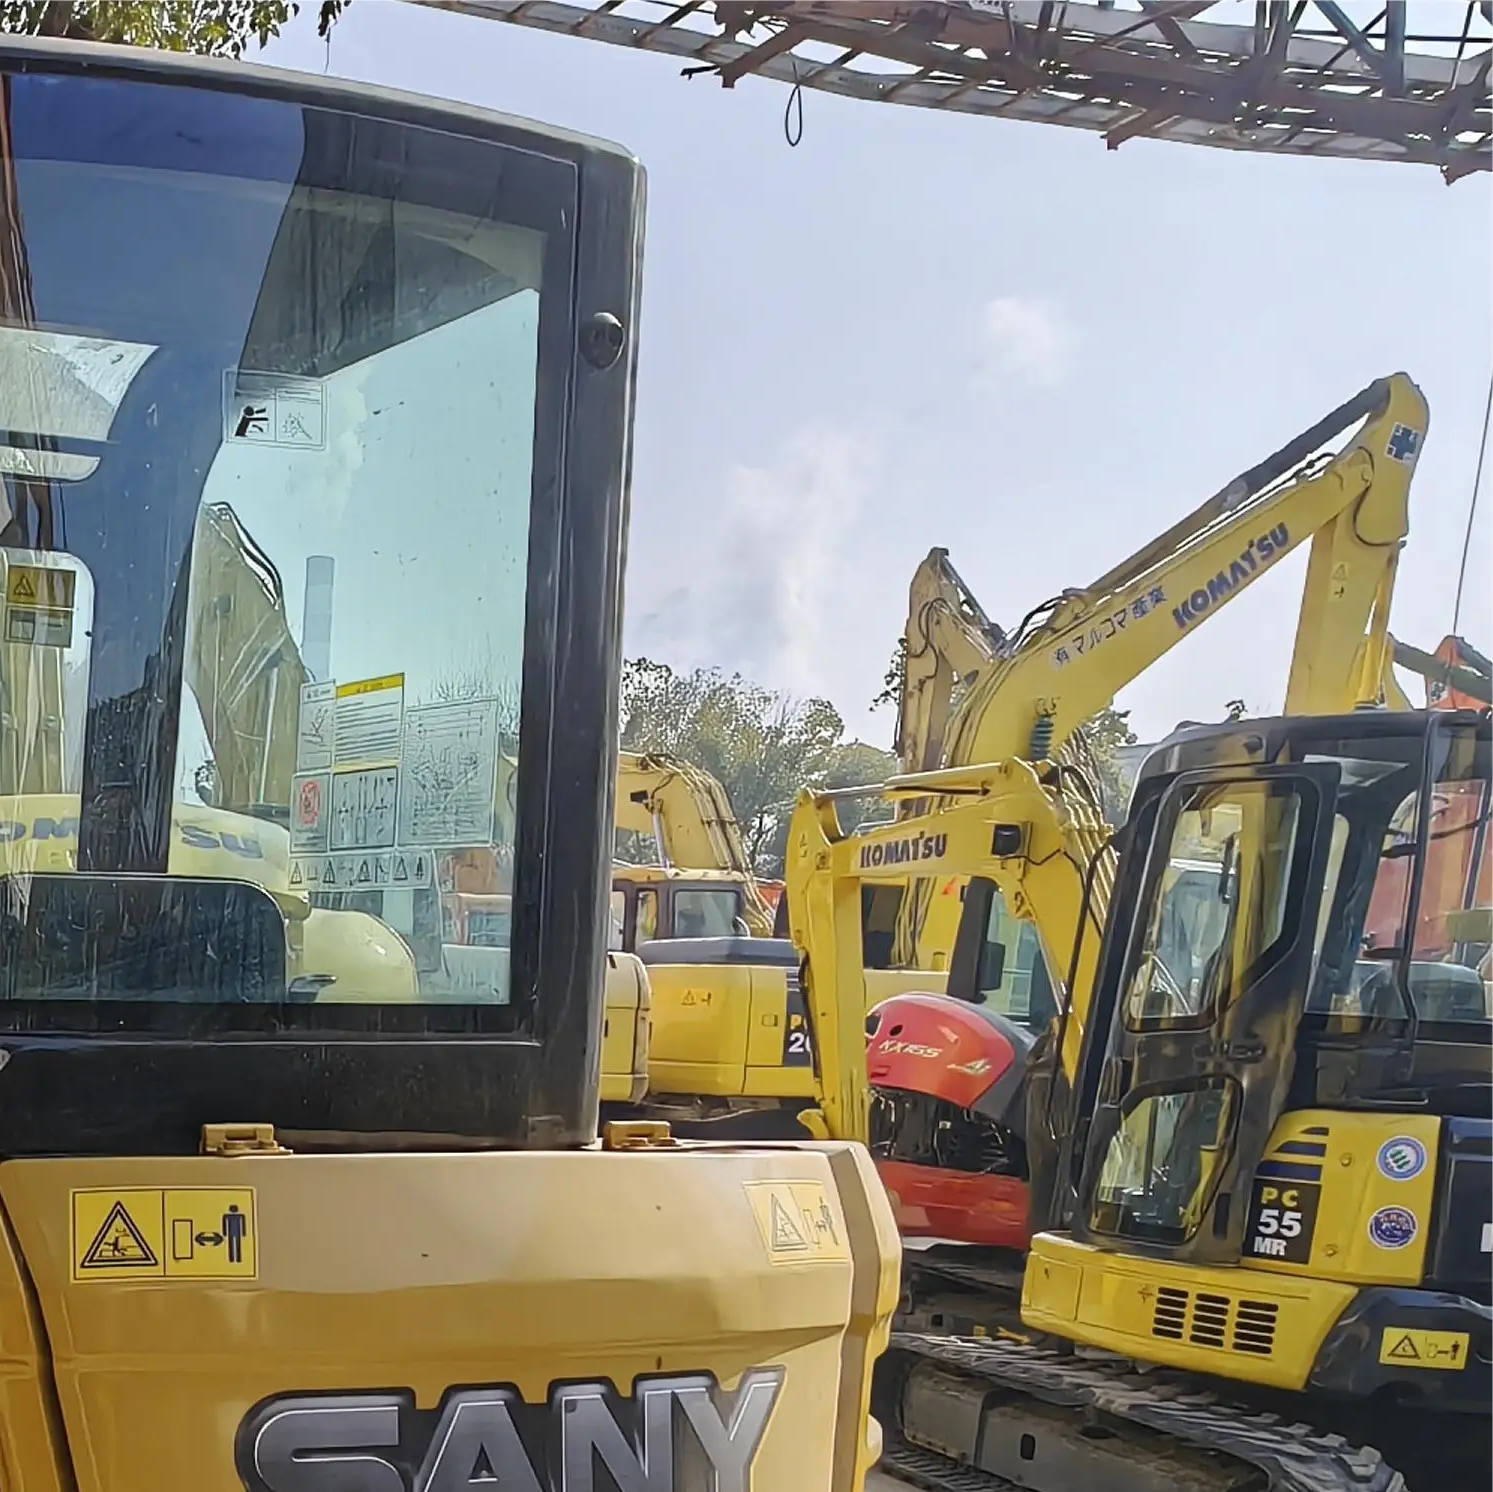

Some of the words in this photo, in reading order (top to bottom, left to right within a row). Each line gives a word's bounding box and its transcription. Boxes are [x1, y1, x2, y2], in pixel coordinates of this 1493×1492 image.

[1172, 522, 1289, 628] KOMATSU
[860, 831, 948, 868] KOMATSU
[1261, 1186, 1299, 1208] PC
[1257, 1209, 1302, 1237] 55
[1253, 1236, 1287, 1256] MR
